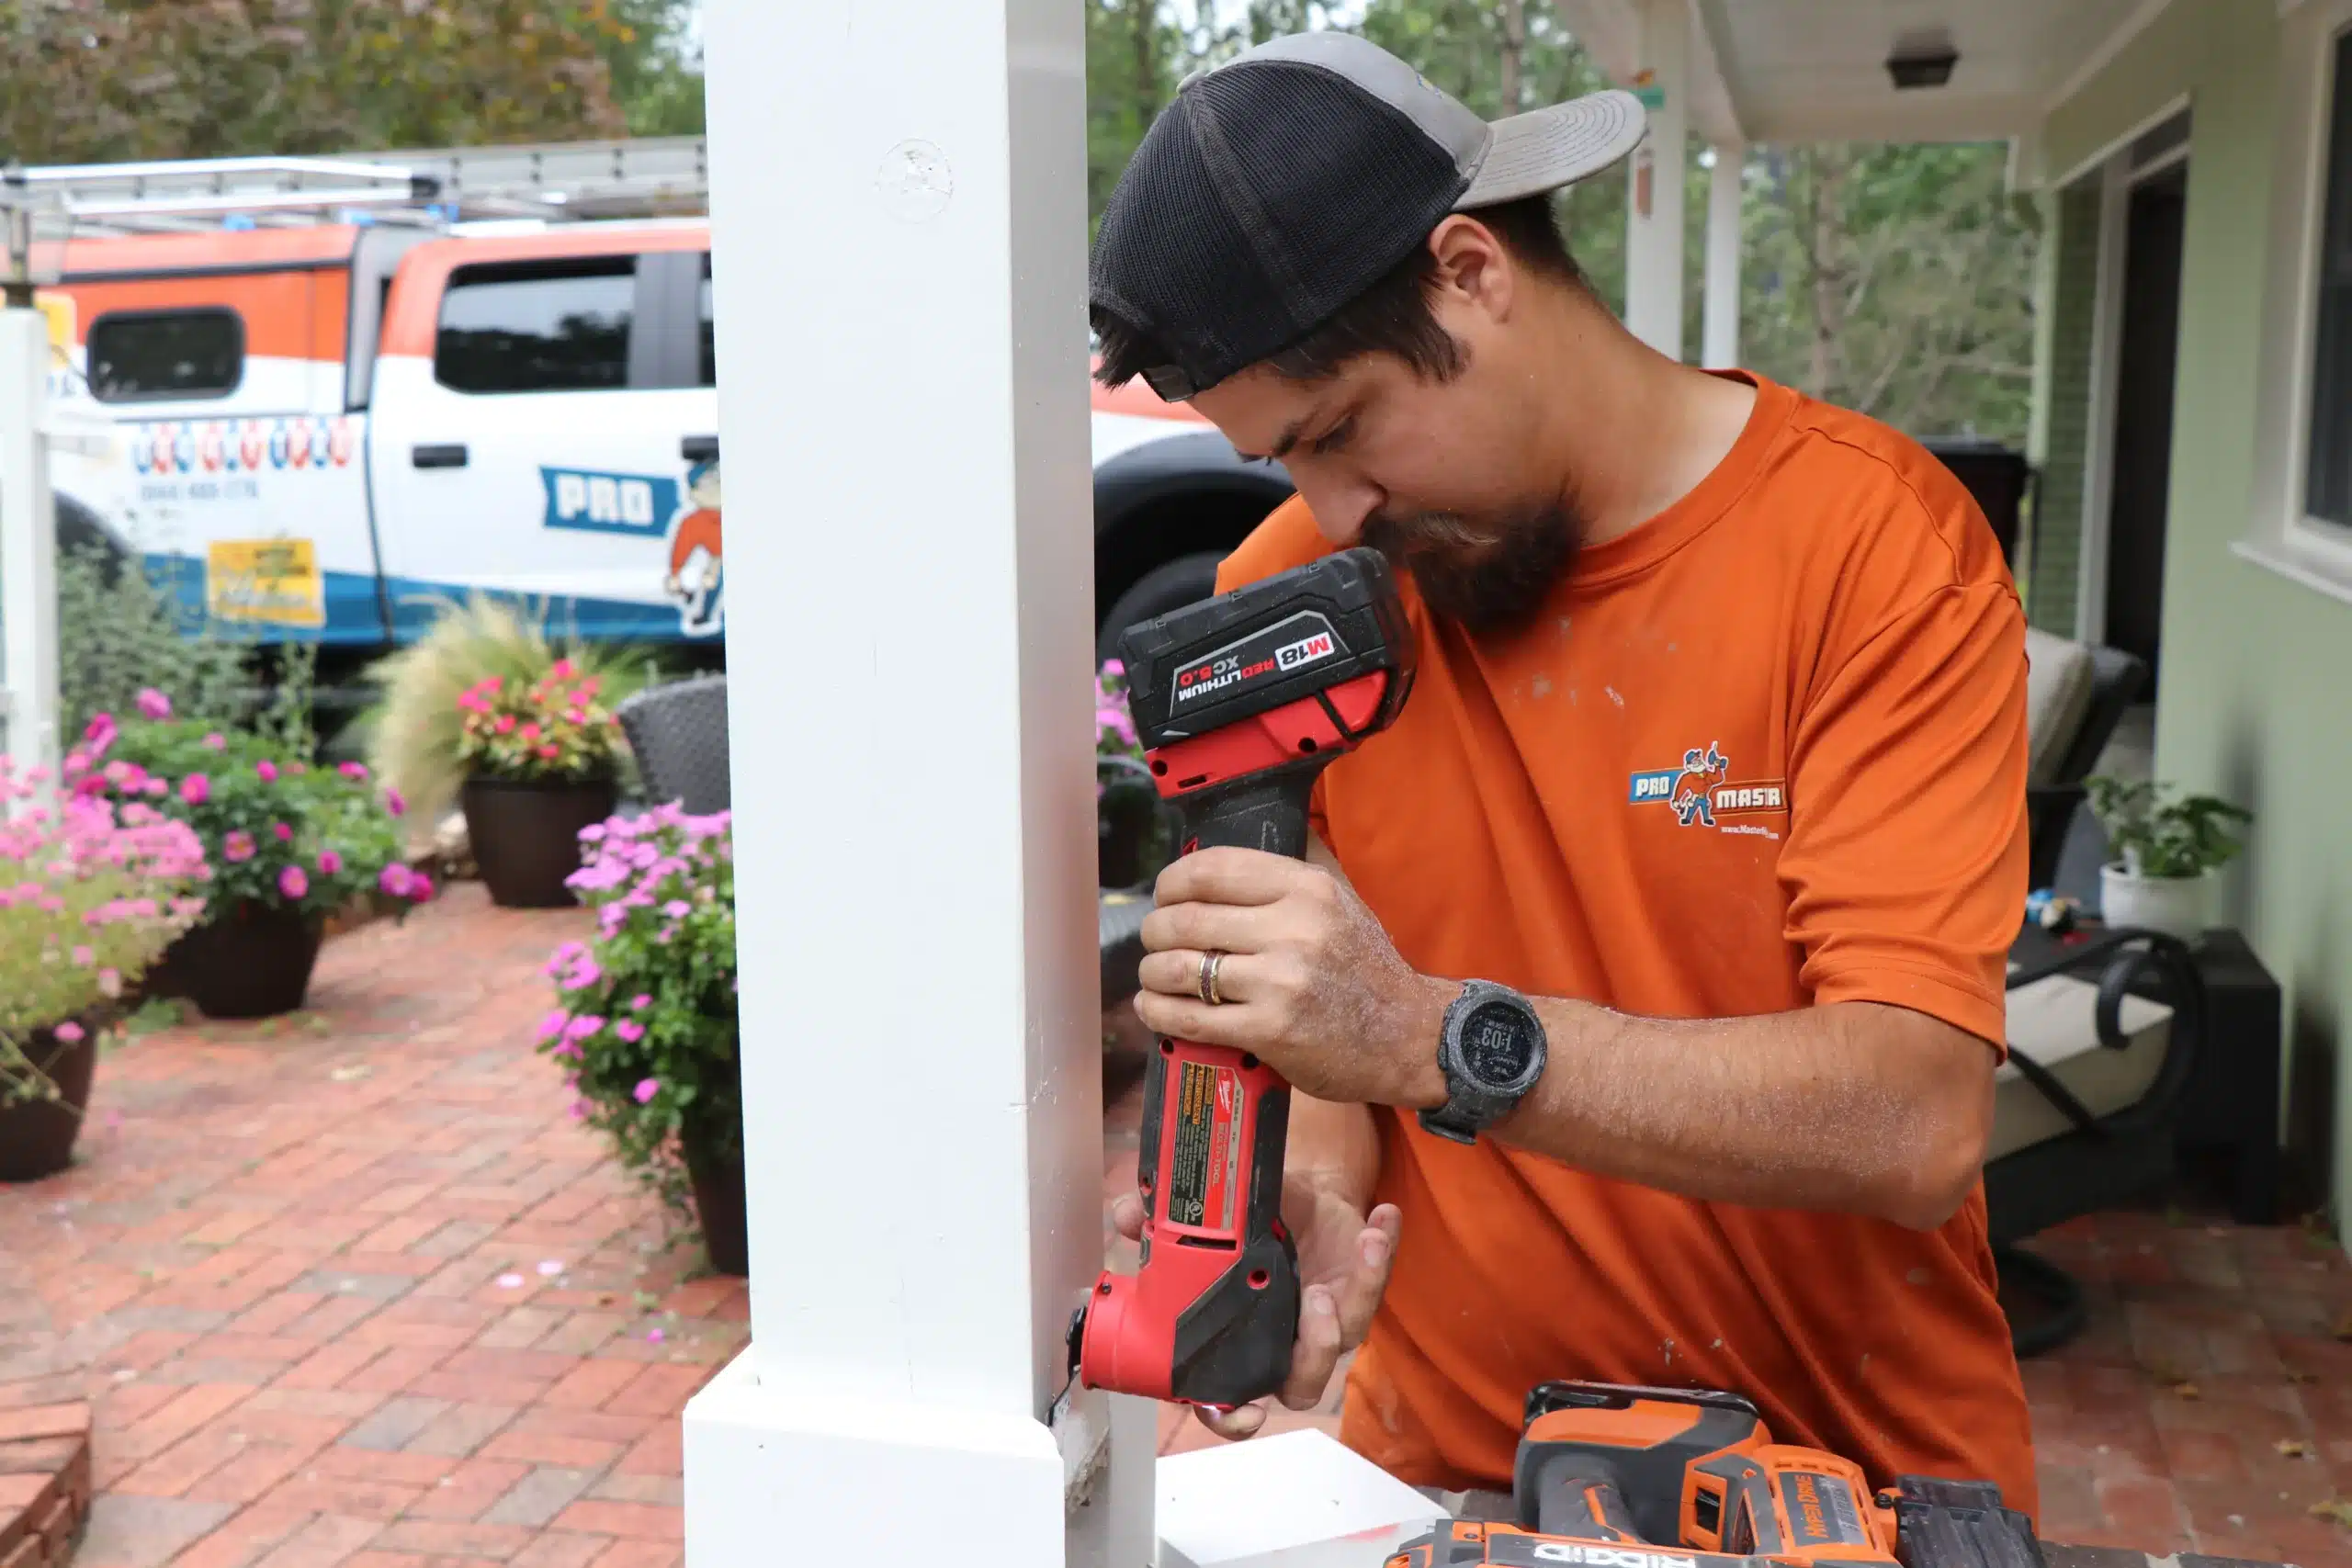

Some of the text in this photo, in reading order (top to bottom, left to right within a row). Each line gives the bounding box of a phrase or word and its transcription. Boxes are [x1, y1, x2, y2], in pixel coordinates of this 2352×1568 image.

[555, 473, 653, 525] PRO
[1282, 637, 1330, 666] M18
[1635, 776, 1669, 797] PRO
[1481, 1027, 1512, 1052] 1:03
